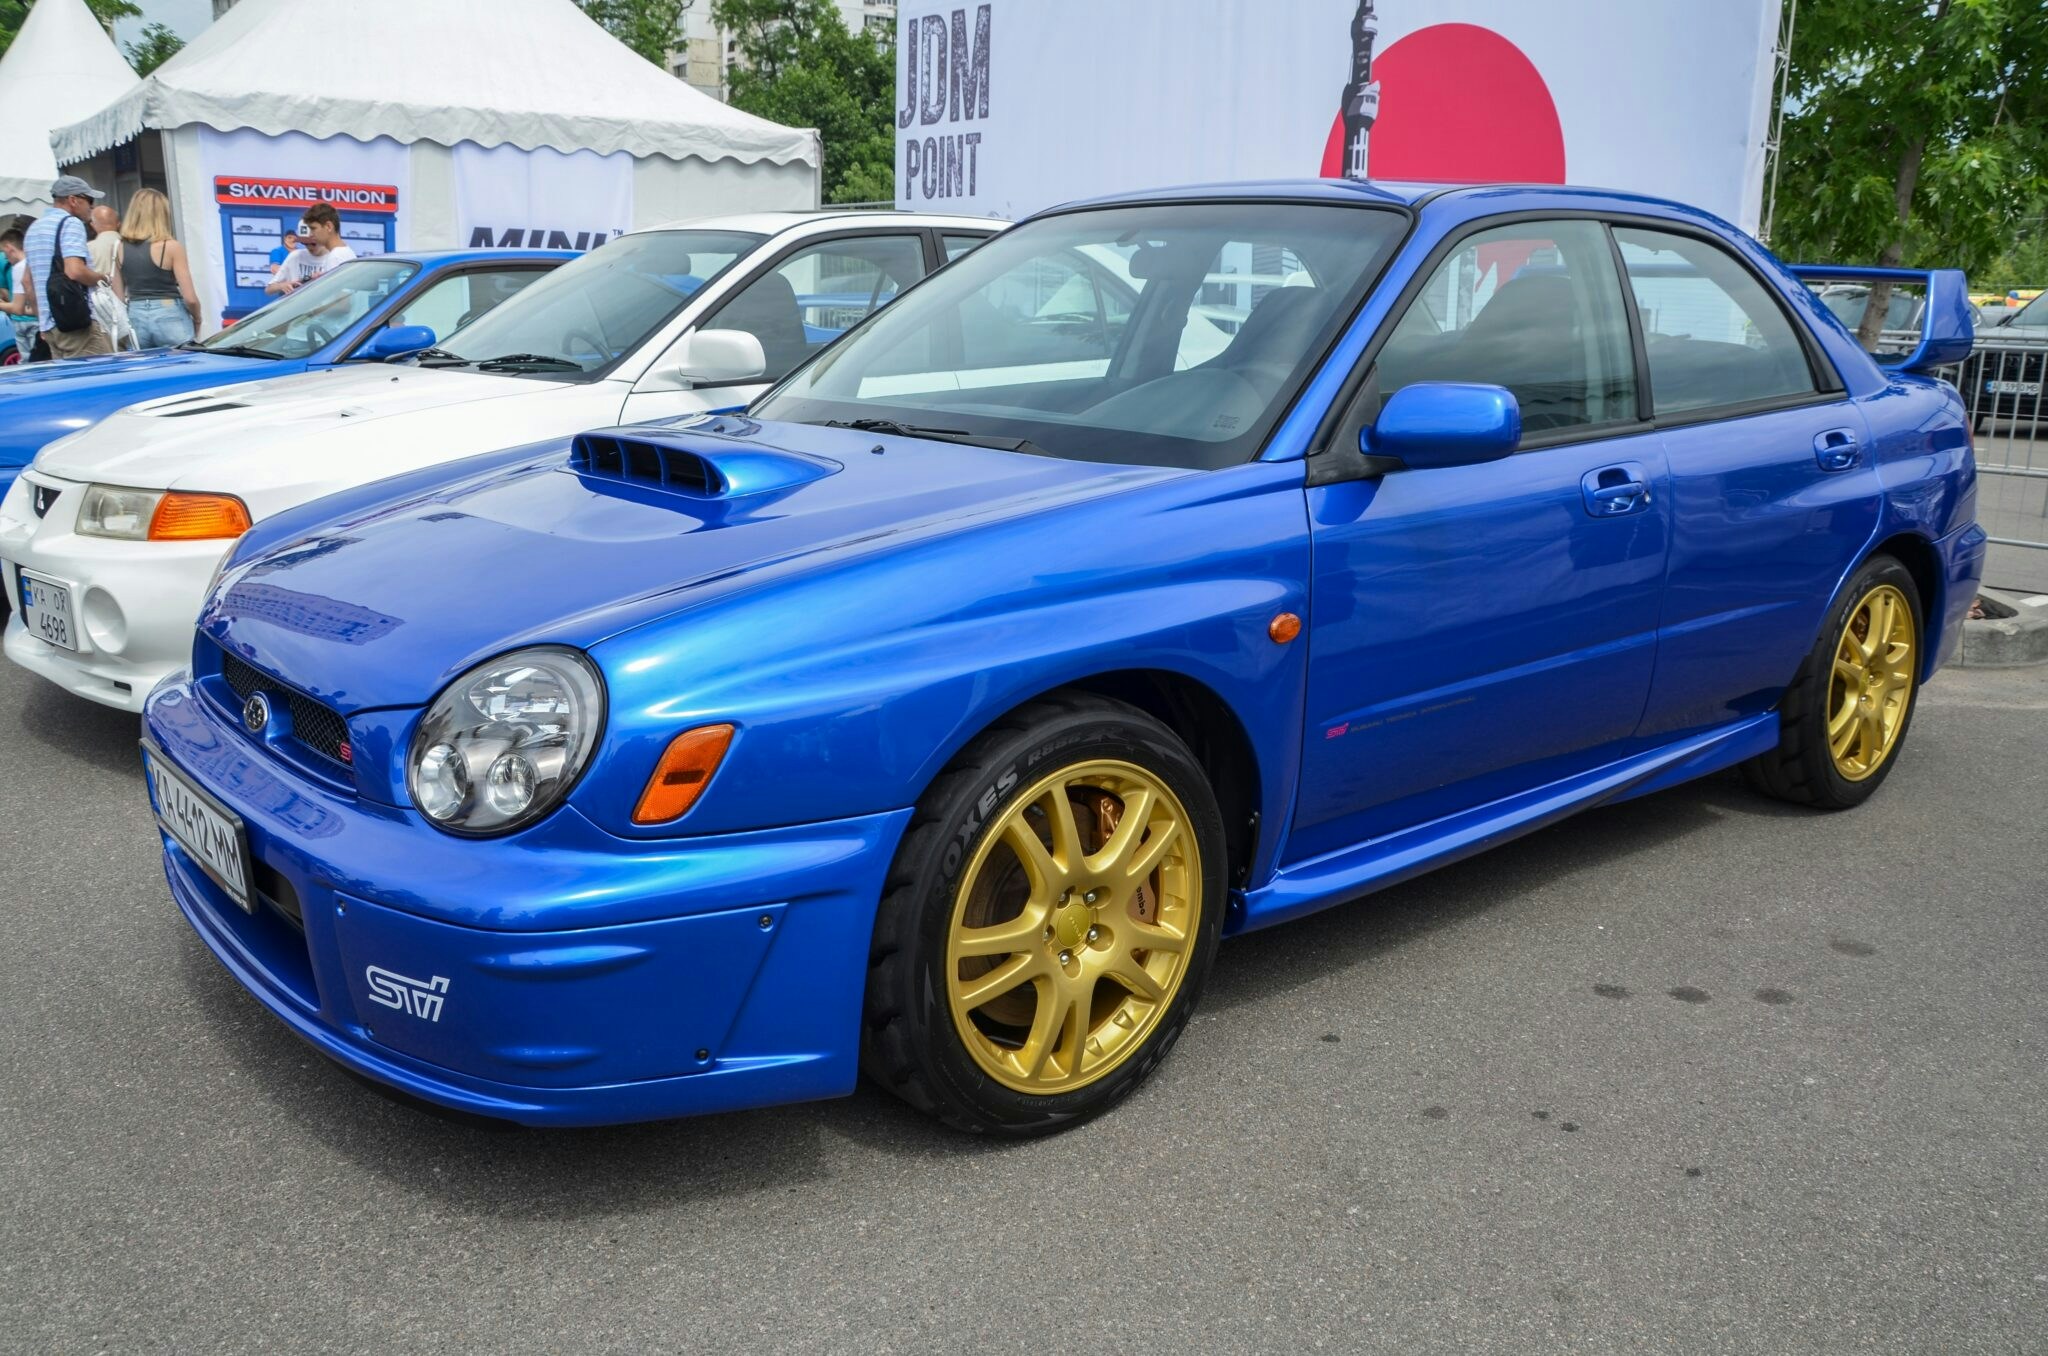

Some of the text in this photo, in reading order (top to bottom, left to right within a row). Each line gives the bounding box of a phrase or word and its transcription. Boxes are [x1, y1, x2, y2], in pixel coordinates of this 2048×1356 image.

[898, 3, 991, 129] JDM
[229, 183, 386, 205] SKVANE UNION
[906, 132, 981, 200] POINT
[41, 612, 67, 643] 4698
[176, 788, 213, 860] 4412
[210, 816, 243, 887] MM
